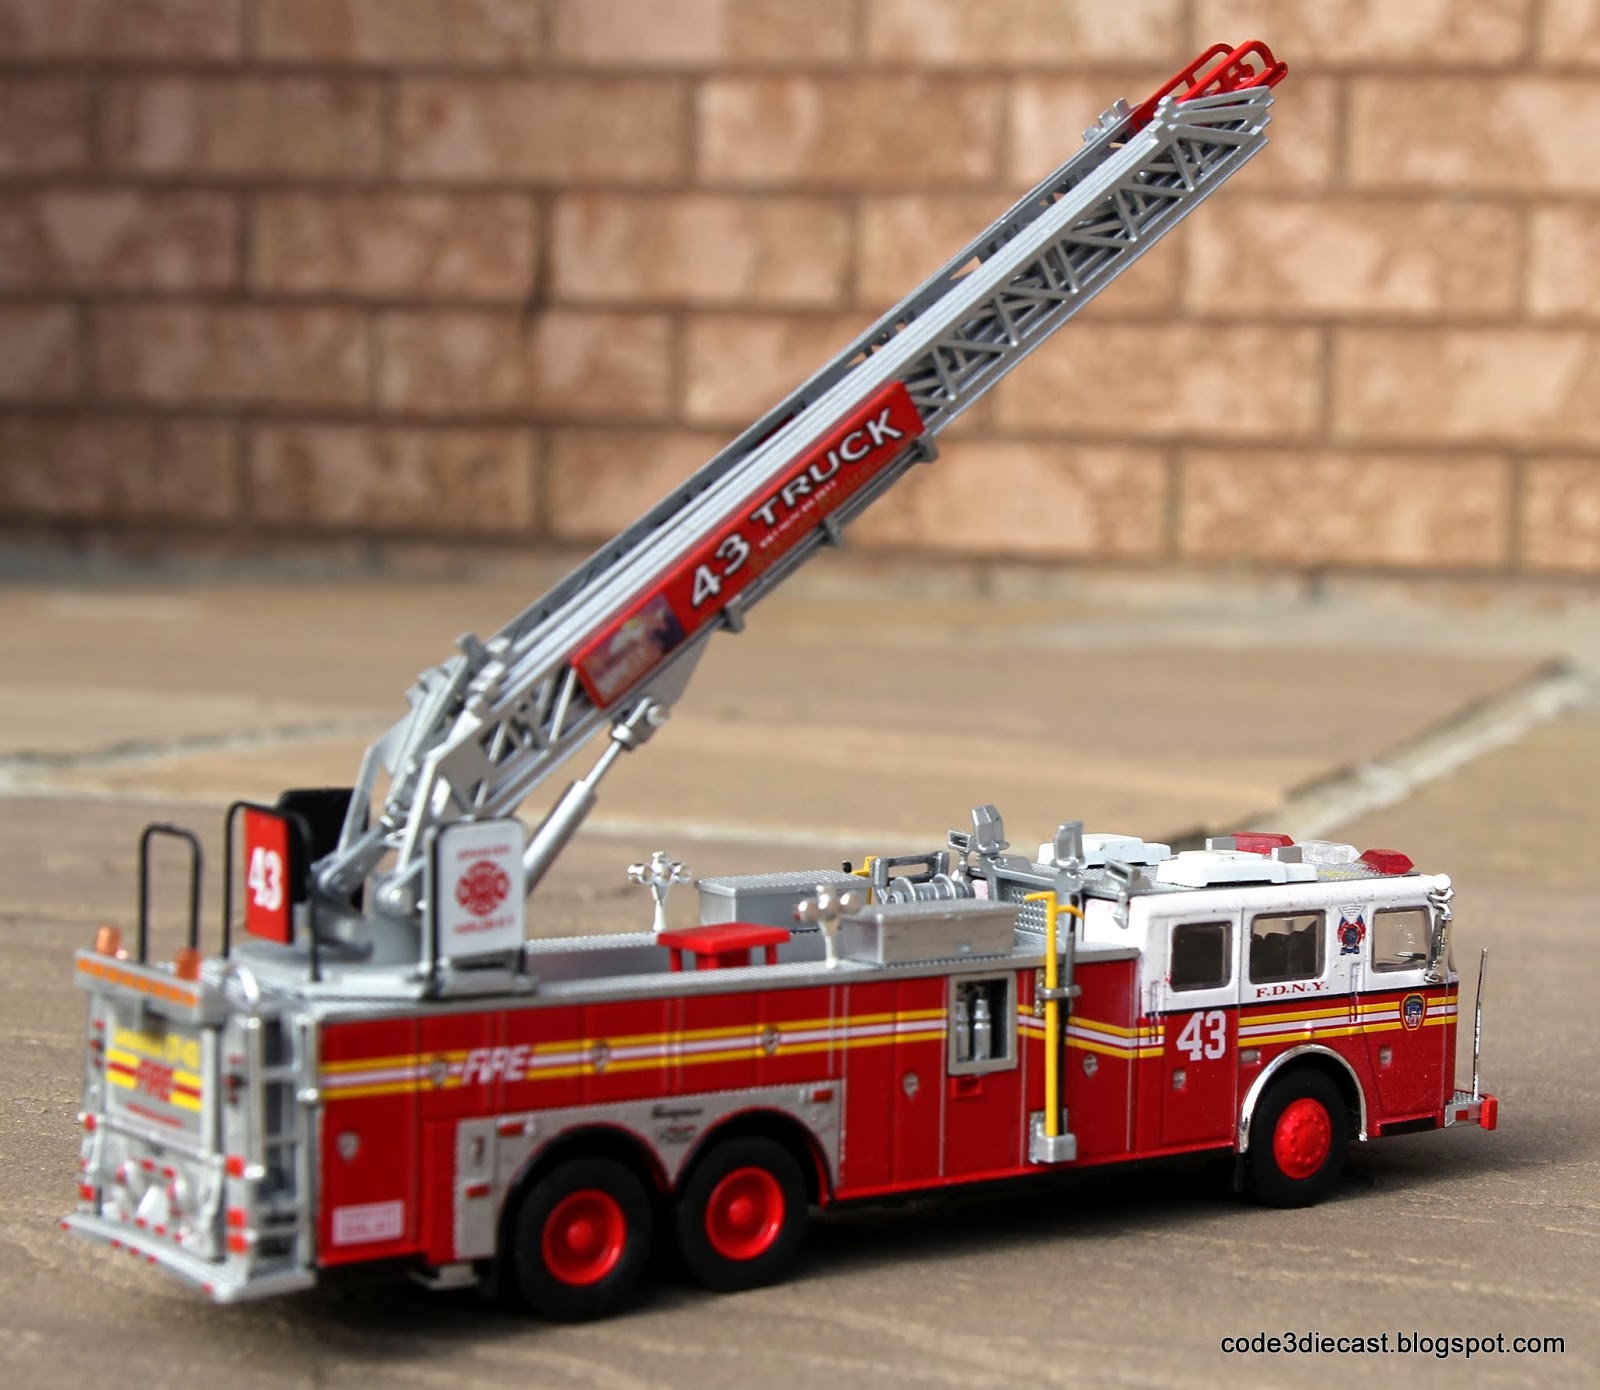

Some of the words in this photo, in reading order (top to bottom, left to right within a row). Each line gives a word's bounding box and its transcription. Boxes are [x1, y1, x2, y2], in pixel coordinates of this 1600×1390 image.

[690, 532, 750, 607] 43
[750, 408, 902, 526] TRUCK
[248, 845, 283, 912] 43
[1256, 981, 1330, 998] F.D.N.Y.
[1176, 1010, 1226, 1061] 43
[462, 1044, 531, 1086] FIRE
